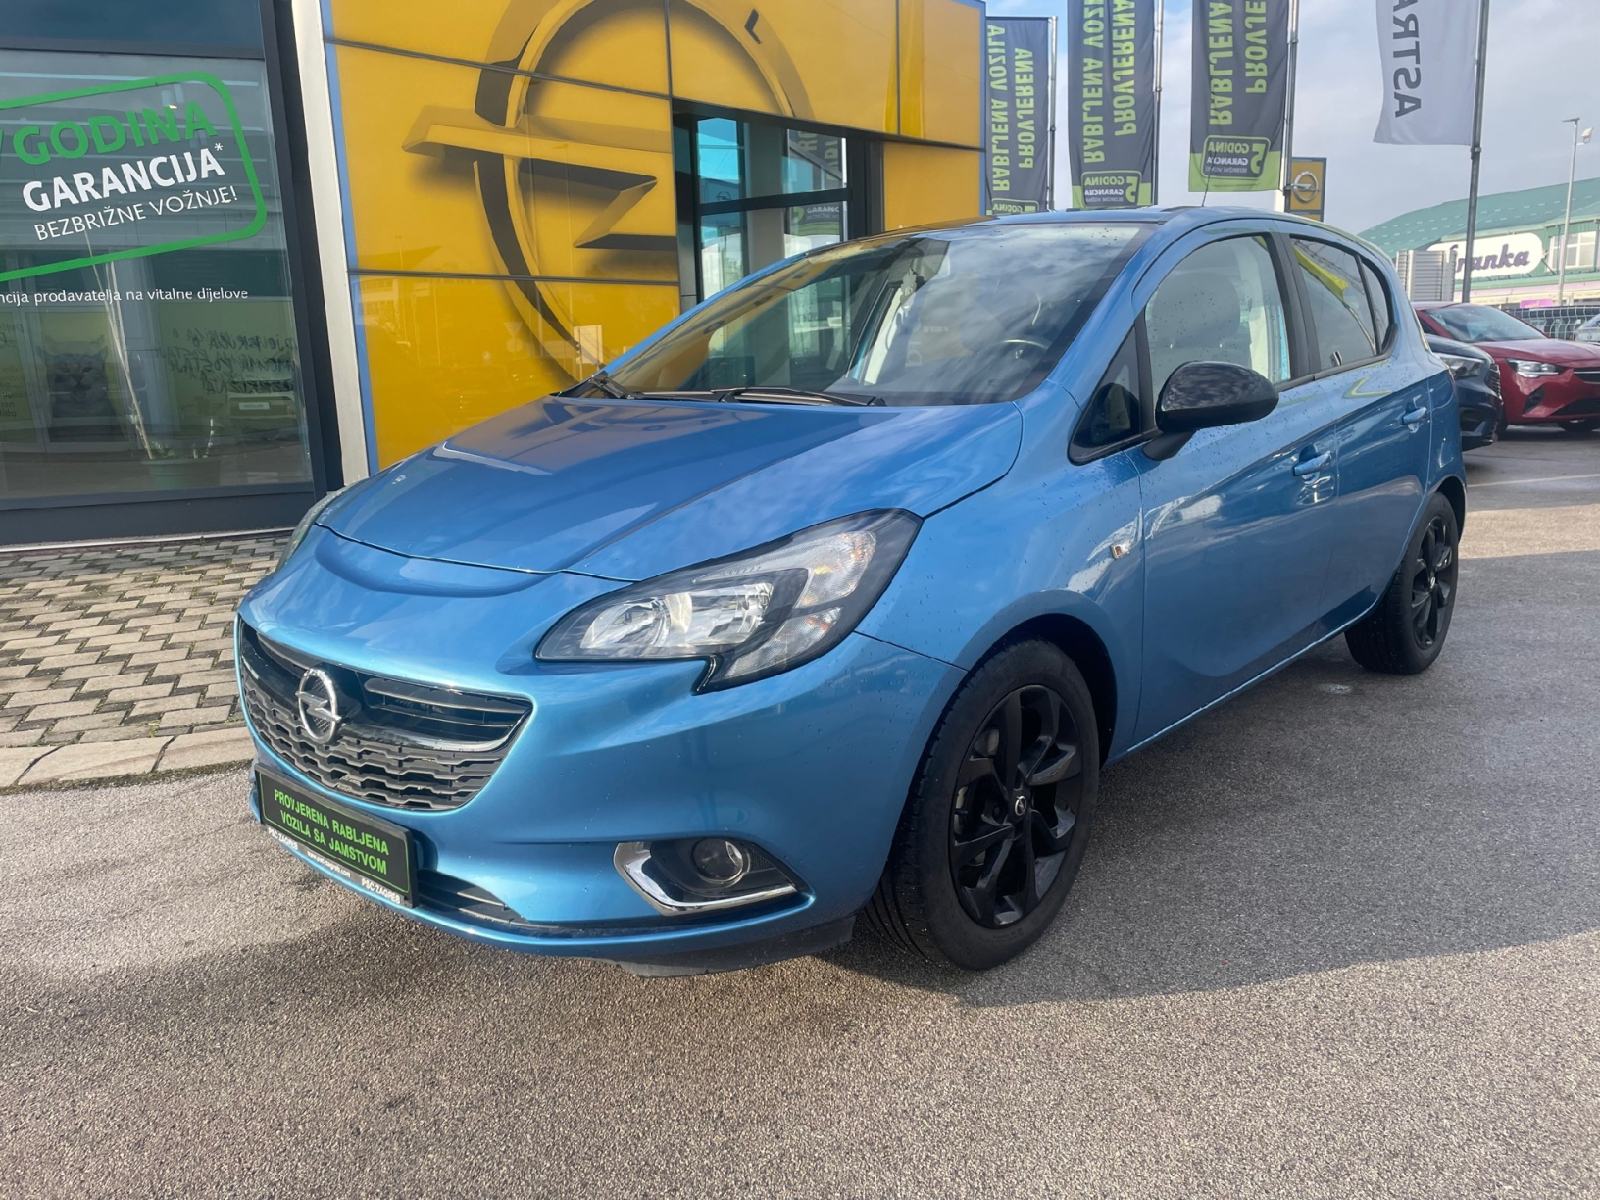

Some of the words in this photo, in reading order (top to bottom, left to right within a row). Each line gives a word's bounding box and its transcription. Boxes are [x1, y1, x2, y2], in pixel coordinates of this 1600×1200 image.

[13, 102, 219, 165] GODINA
[34, 205, 146, 241] BEZBRIŽNE
[149, 185, 238, 215] VOŽNJE!
[1450, 243, 1531, 273] ranka
[34, 289, 122, 306] prodavatelja
[126, 290, 144, 300] na
[147, 287, 193, 300] vitalne
[197, 286, 249, 303] dijelove
[274, 789, 330, 829] PROVJERENA
[332, 819, 389, 855] RABLJENA
[280, 810, 311, 838] VOZILA
[313, 828, 326, 845] SA
[328, 837, 387, 875] JAMSTVOM
